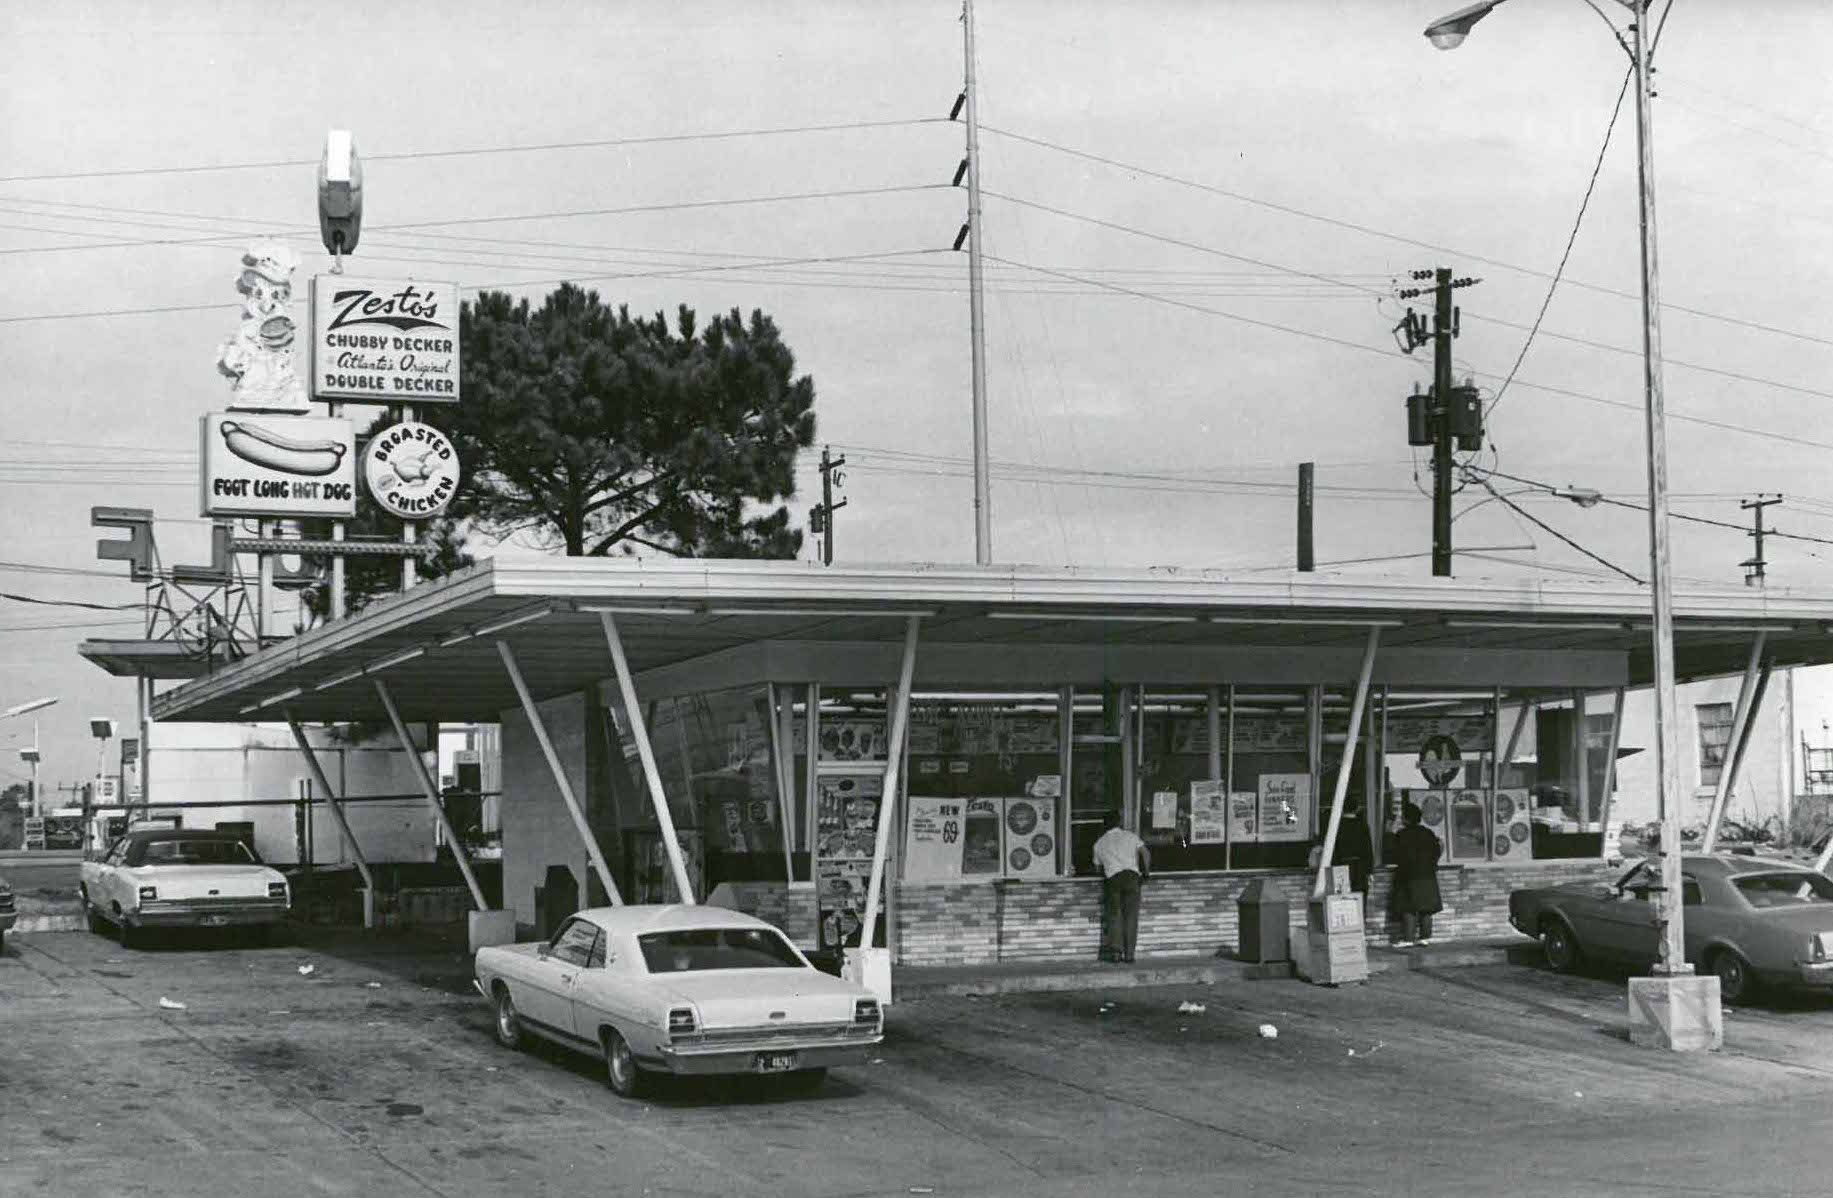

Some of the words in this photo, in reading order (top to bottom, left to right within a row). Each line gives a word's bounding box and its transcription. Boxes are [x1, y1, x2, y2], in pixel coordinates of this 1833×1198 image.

[328, 286, 437, 331] Zesto's
[326, 333, 388, 350] CHUBBY
[392, 337, 453, 353] DECKER
[400, 354, 451, 377] Original
[325, 373, 385, 390] DOUBLE
[393, 377, 454, 393] DECKER
[375, 427, 451, 462] BROASTED
[213, 478, 251, 497] FOOT
[253, 479, 289, 498] LONG
[291, 481, 320, 499] HOT
[322, 482, 352, 501] DOG
[387, 476, 454, 511] CHICKEN
[940, 804, 960, 817] NEW
